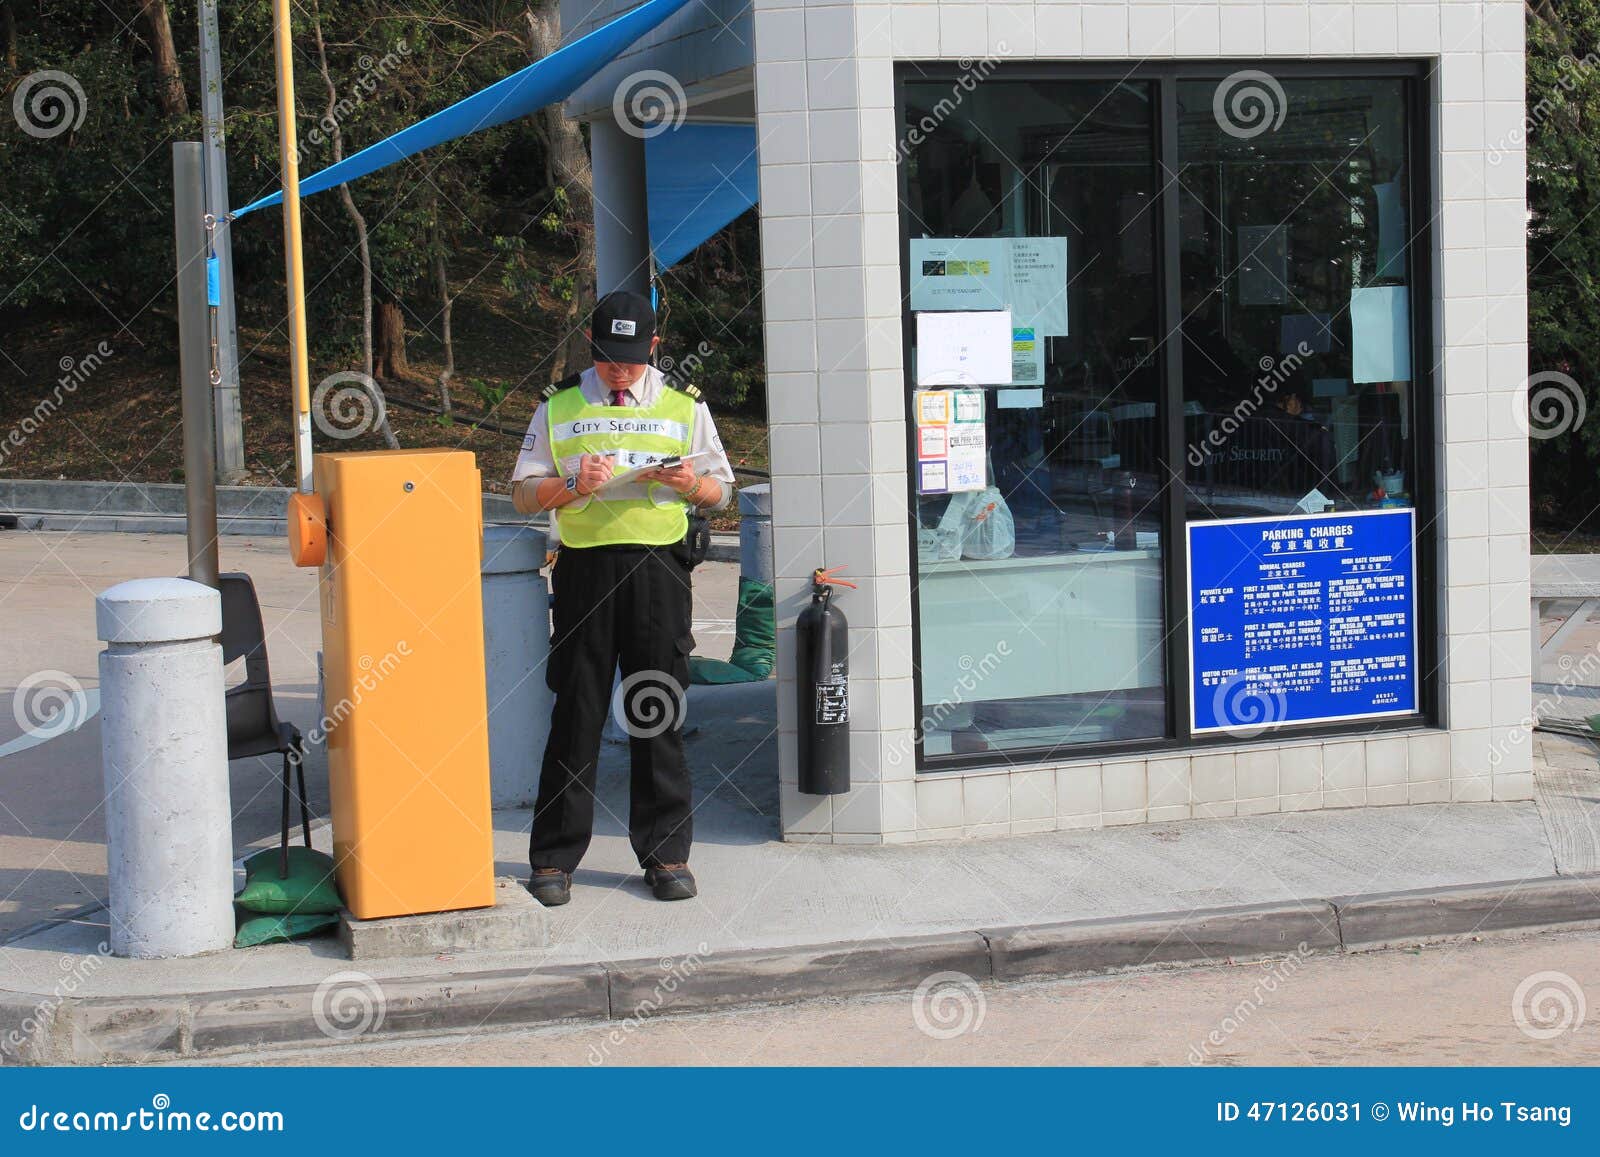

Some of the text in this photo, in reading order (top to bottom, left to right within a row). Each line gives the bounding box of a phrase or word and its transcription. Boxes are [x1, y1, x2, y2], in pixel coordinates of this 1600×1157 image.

[1262, 525, 1353, 541] PARKING CHARGES
[1260, 563, 1280, 571] NORMAL
[1200, 588, 1222, 596] PRIVATE
[1201, 627, 1219, 635] COACH
[1202, 670, 1220, 678] MOTOR
